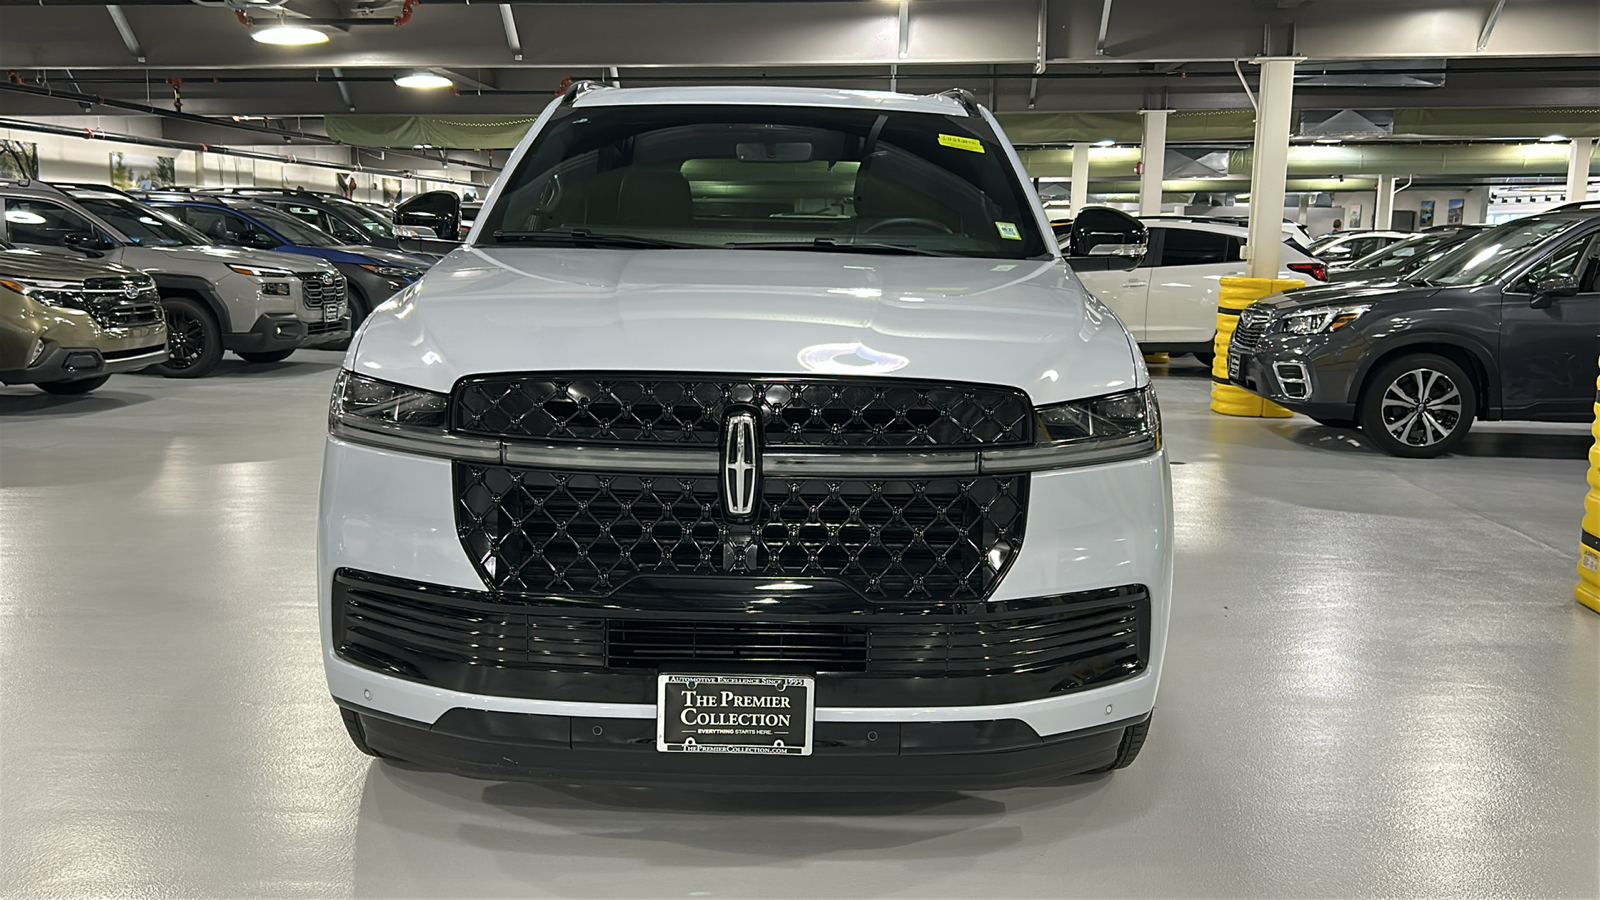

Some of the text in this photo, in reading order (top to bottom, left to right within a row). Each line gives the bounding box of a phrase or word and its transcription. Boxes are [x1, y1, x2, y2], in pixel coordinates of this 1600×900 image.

[718, 676, 760, 685] EXCELLENCE
[681, 690, 791, 708] THE PREMIER
[680, 707, 791, 727] COLLECTION
